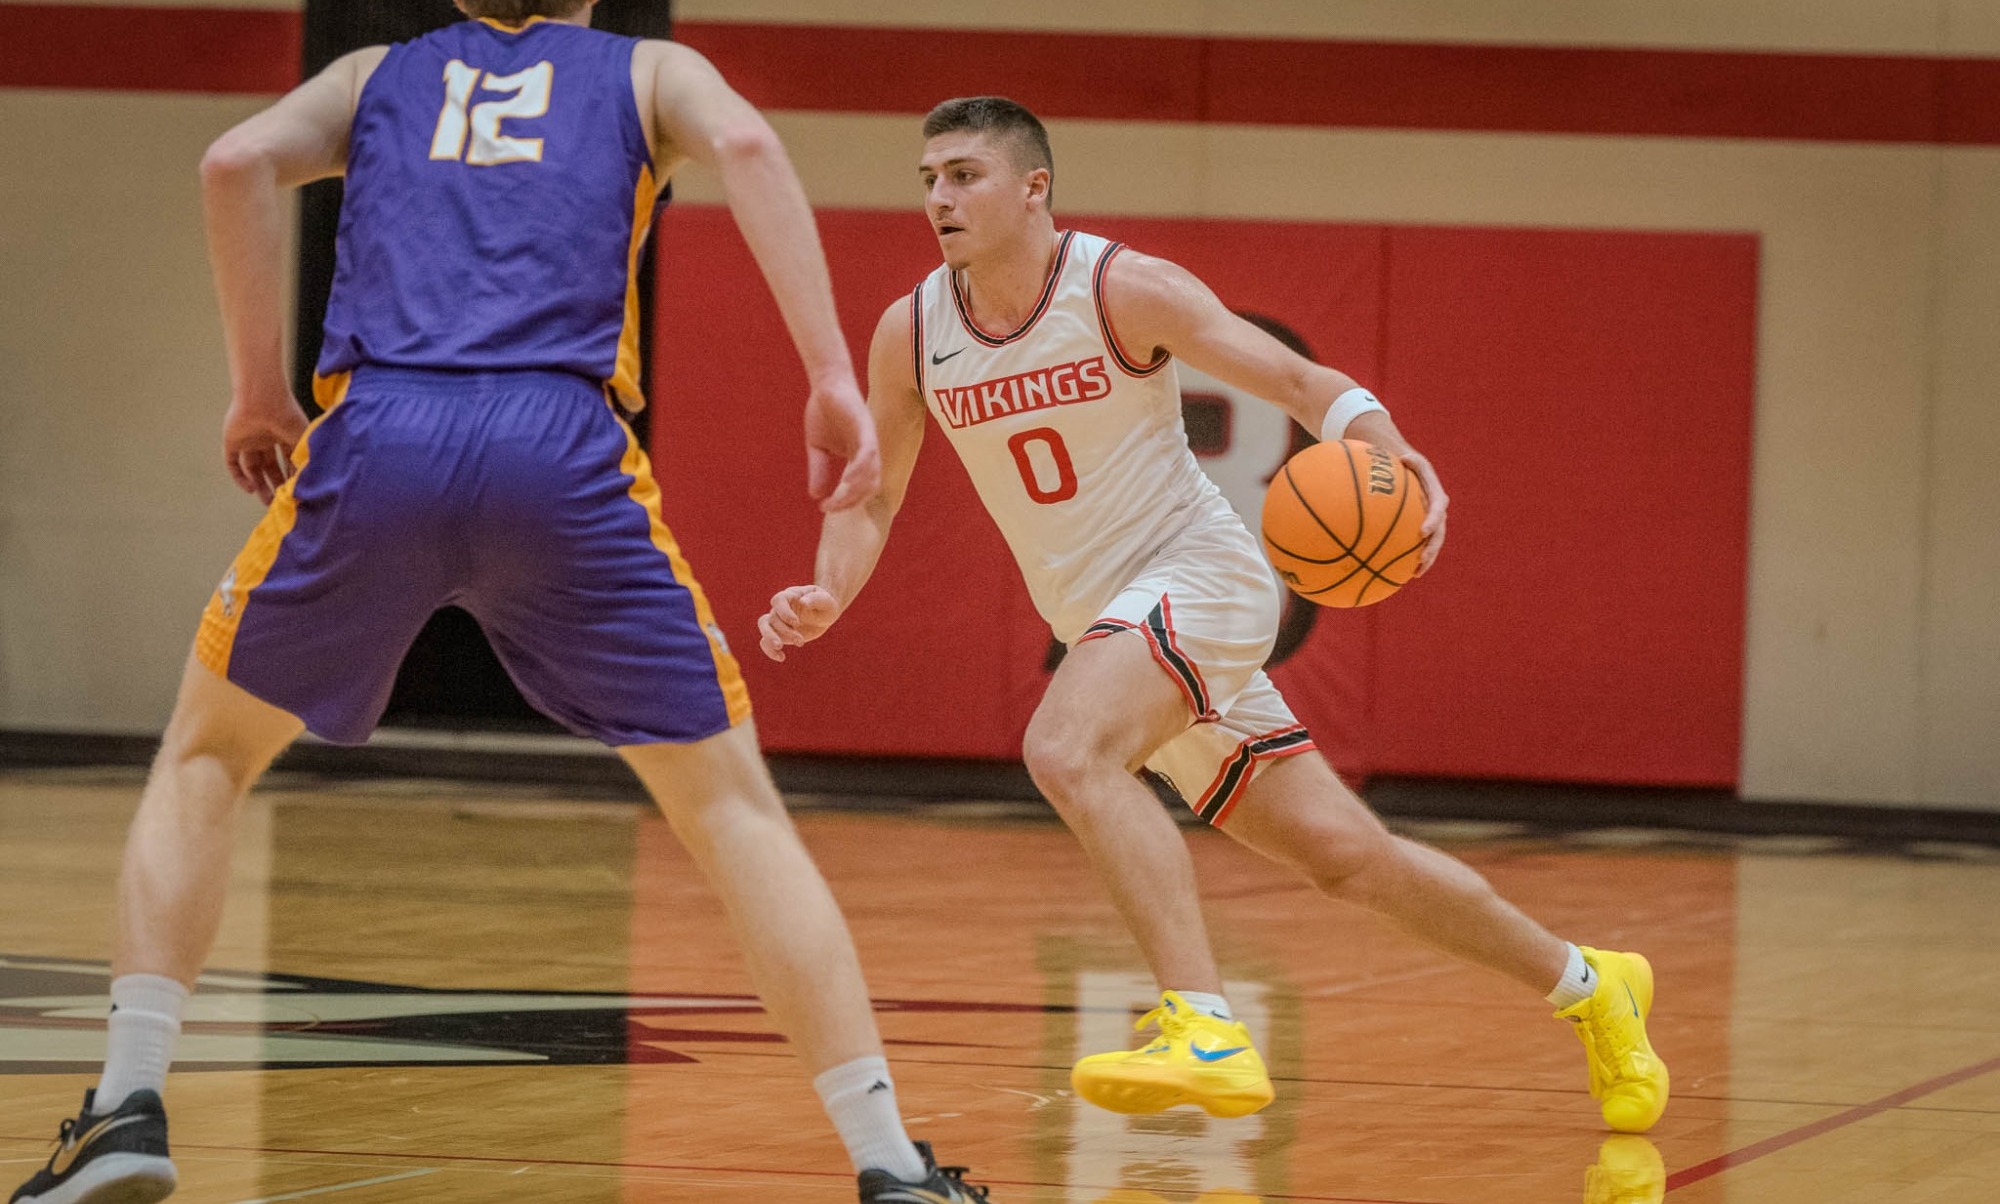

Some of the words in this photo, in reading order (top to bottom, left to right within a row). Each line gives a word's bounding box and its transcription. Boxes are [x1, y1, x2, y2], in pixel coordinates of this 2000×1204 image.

[429, 59, 554, 166] 12
[933, 356, 1112, 429] VIKINGS
[1007, 427, 1078, 504] 0
[1365, 445, 1396, 496] Wil
